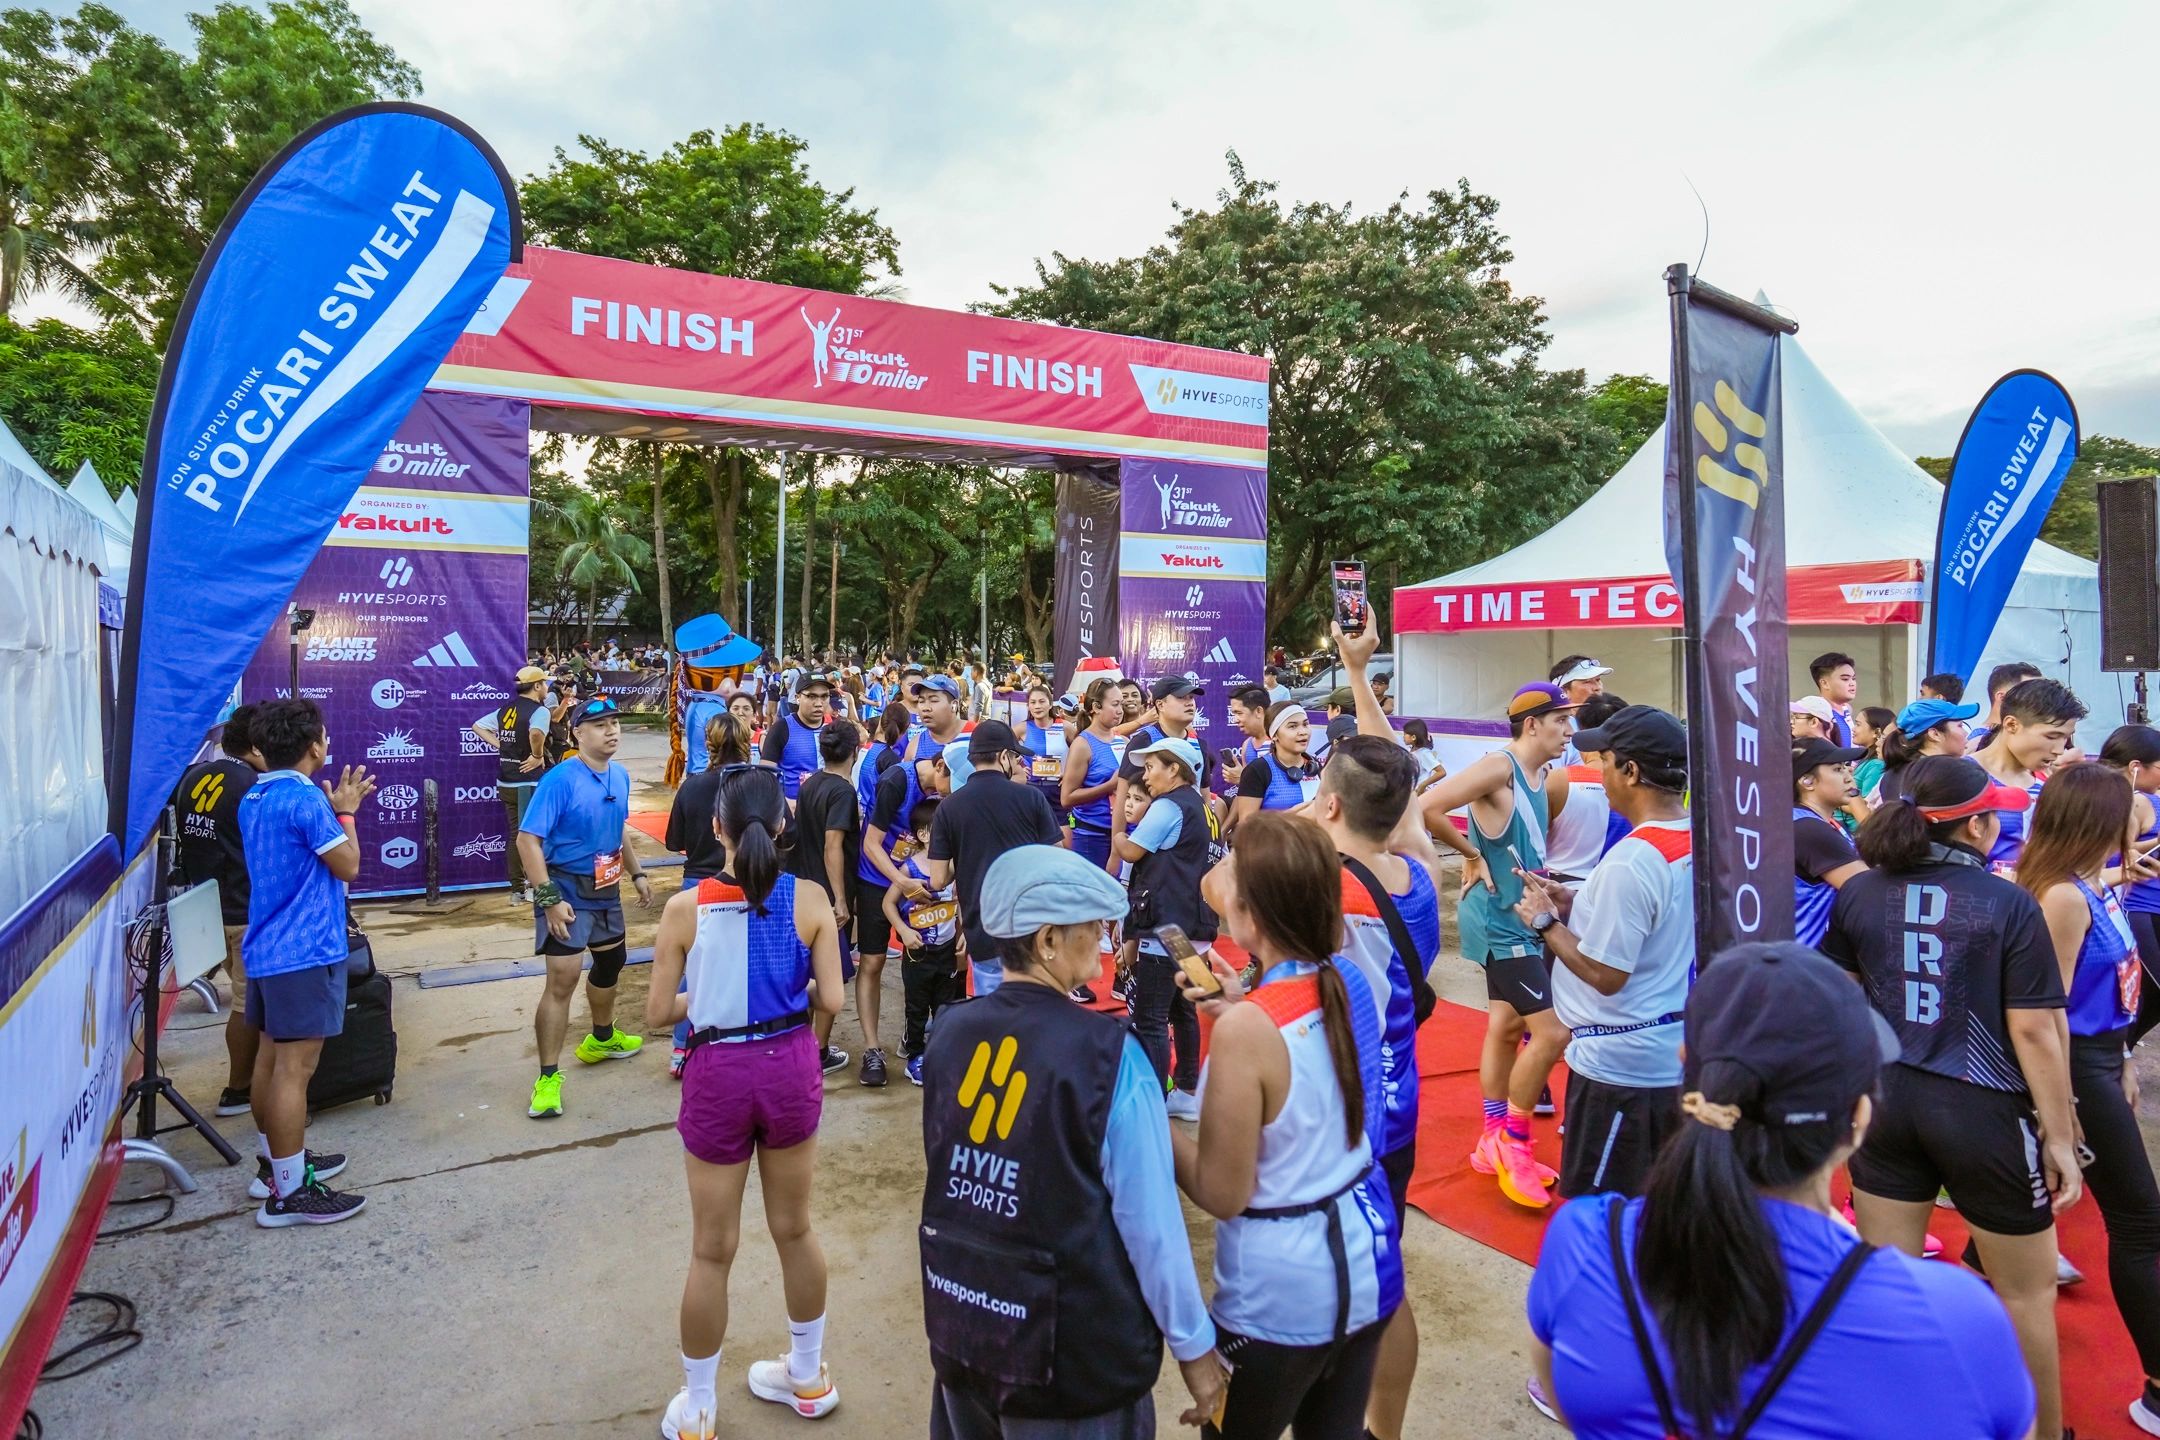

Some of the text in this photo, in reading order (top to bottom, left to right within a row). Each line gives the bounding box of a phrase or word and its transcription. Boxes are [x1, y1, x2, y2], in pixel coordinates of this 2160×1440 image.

[571, 296, 754, 357] FINISH
[185, 170, 442, 512] POCARI SWEAT
[830, 345, 909, 368] Yakult
[829, 362, 928, 391] 10 miler
[967, 350, 1102, 398] FINISH
[1182, 388, 1264, 410] HYVESPORTS
[168, 367, 263, 491] ION SUPPLY DRINK
[384, 440, 448, 457] kult
[372, 454, 471, 478] 0 miler
[360, 500, 413, 509] ORGANIZED
[1952, 406, 2048, 586] POCARI SWEAT
[1171, 500, 1220, 512] Yakult
[338, 513, 454, 535] Yakult
[1173, 512, 1232, 528] 10 miler
[1944, 510, 1979, 575] ION SUPPLY DRINK
[1161, 554, 1224, 569] Yakult
[1080, 516, 1093, 659] VESPORTS
[1866, 587, 1922, 597] HYVESPORTS
[338, 592, 447, 606] HYVESPORTS
[1433, 584, 1678, 623] TIME TEC
[380, 615, 429, 623] SPONSORS
[1164, 610, 1221, 619] HYVESPORTS
[308, 637, 378, 649] PLANET
[1149, 641, 1185, 651] PLANET
[304, 649, 377, 661] SPORTS
[1148, 650, 1185, 660] SPORTS
[381, 684, 404, 703] sip
[451, 692, 510, 700] BLACKWOOD
[601, 686, 661, 696] HYVESPORTS
[1731, 536, 1760, 933] HYVESPO
[383, 785, 414, 797] BREW
[383, 797, 413, 808] BOY
[185, 813, 215, 830] HYVE
[378, 810, 417, 821] CAFE
[184, 825, 216, 840] SPORTS
[385, 847, 414, 859] GU
[918, 907, 948, 925] 3010
[62, 1040, 115, 1160] HYVESPORTS
[950, 1144, 1020, 1190] HYVE
[946, 1176, 1019, 1218] SPORTS
